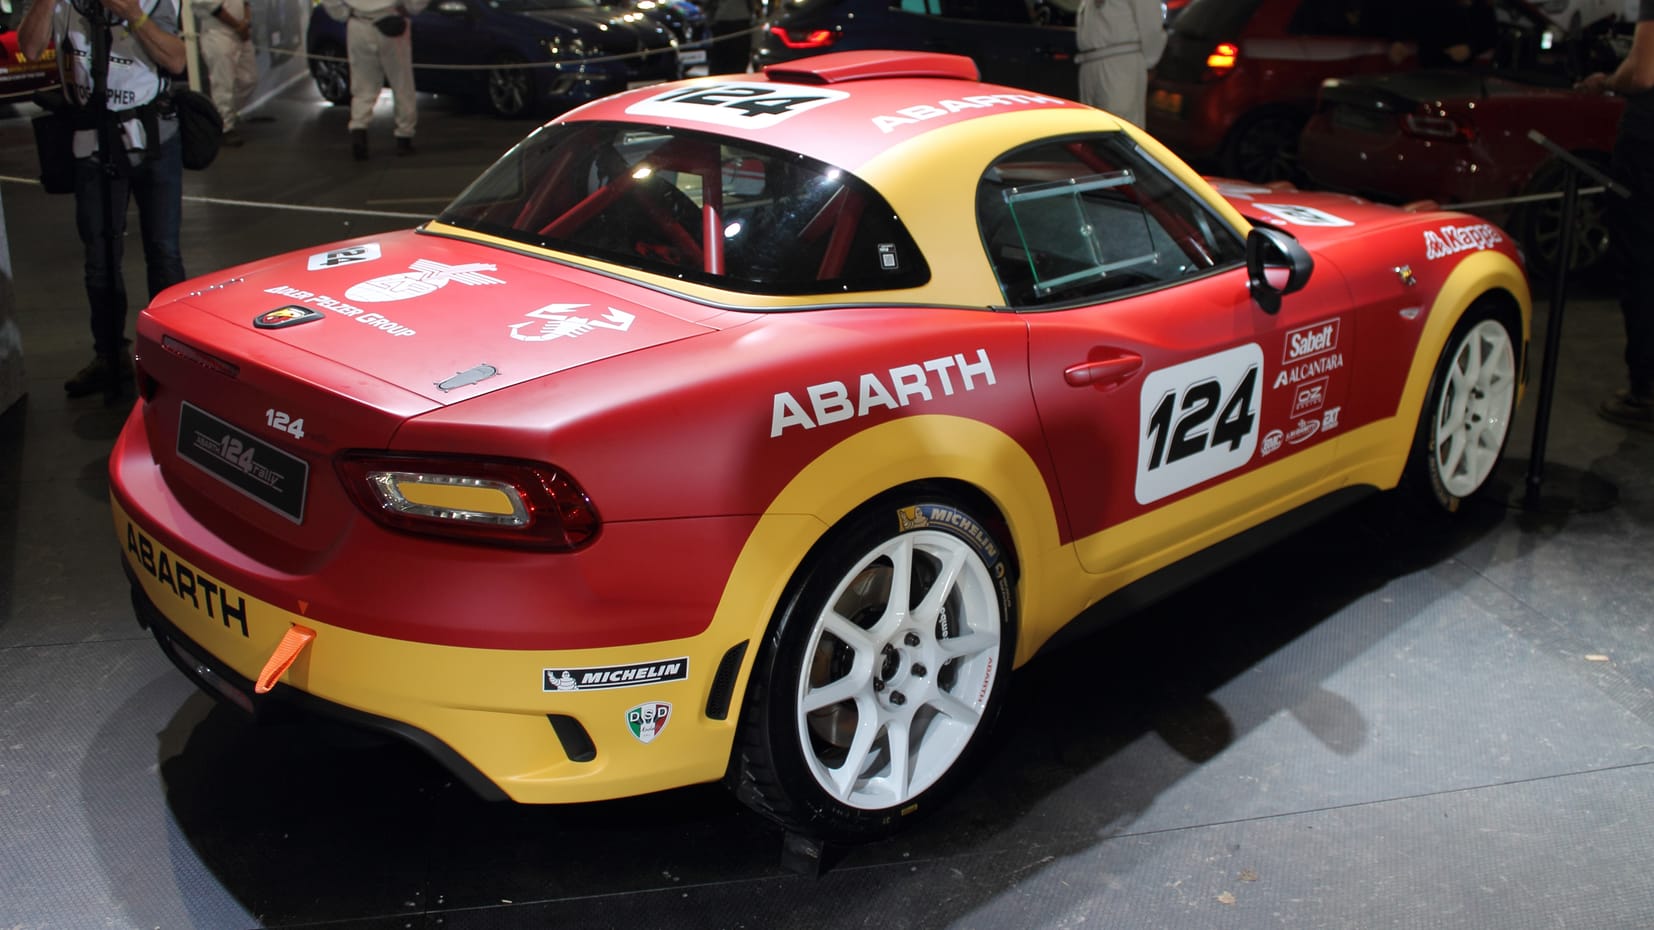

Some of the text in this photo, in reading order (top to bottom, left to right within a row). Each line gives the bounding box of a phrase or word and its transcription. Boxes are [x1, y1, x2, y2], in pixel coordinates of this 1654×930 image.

[655, 85, 829, 117] 124
[872, 94, 1064, 134] ABARTH
[1440, 224, 1502, 255] Kappa
[263, 285, 416, 337] ADLER PELZER GROUP
[1290, 325, 1333, 358] Sabelt
[1289, 353, 1343, 383] ALCANTARA
[770, 349, 996, 438] ABARTH
[266, 408, 304, 439] 124
[1148, 365, 1258, 471] 124
[219, 435, 255, 474] 124
[252, 465, 279, 487] rally
[930, 508, 997, 558] MICHELIN
[127, 521, 249, 638] ABARTH
[581, 663, 681, 684] MICHELIN
